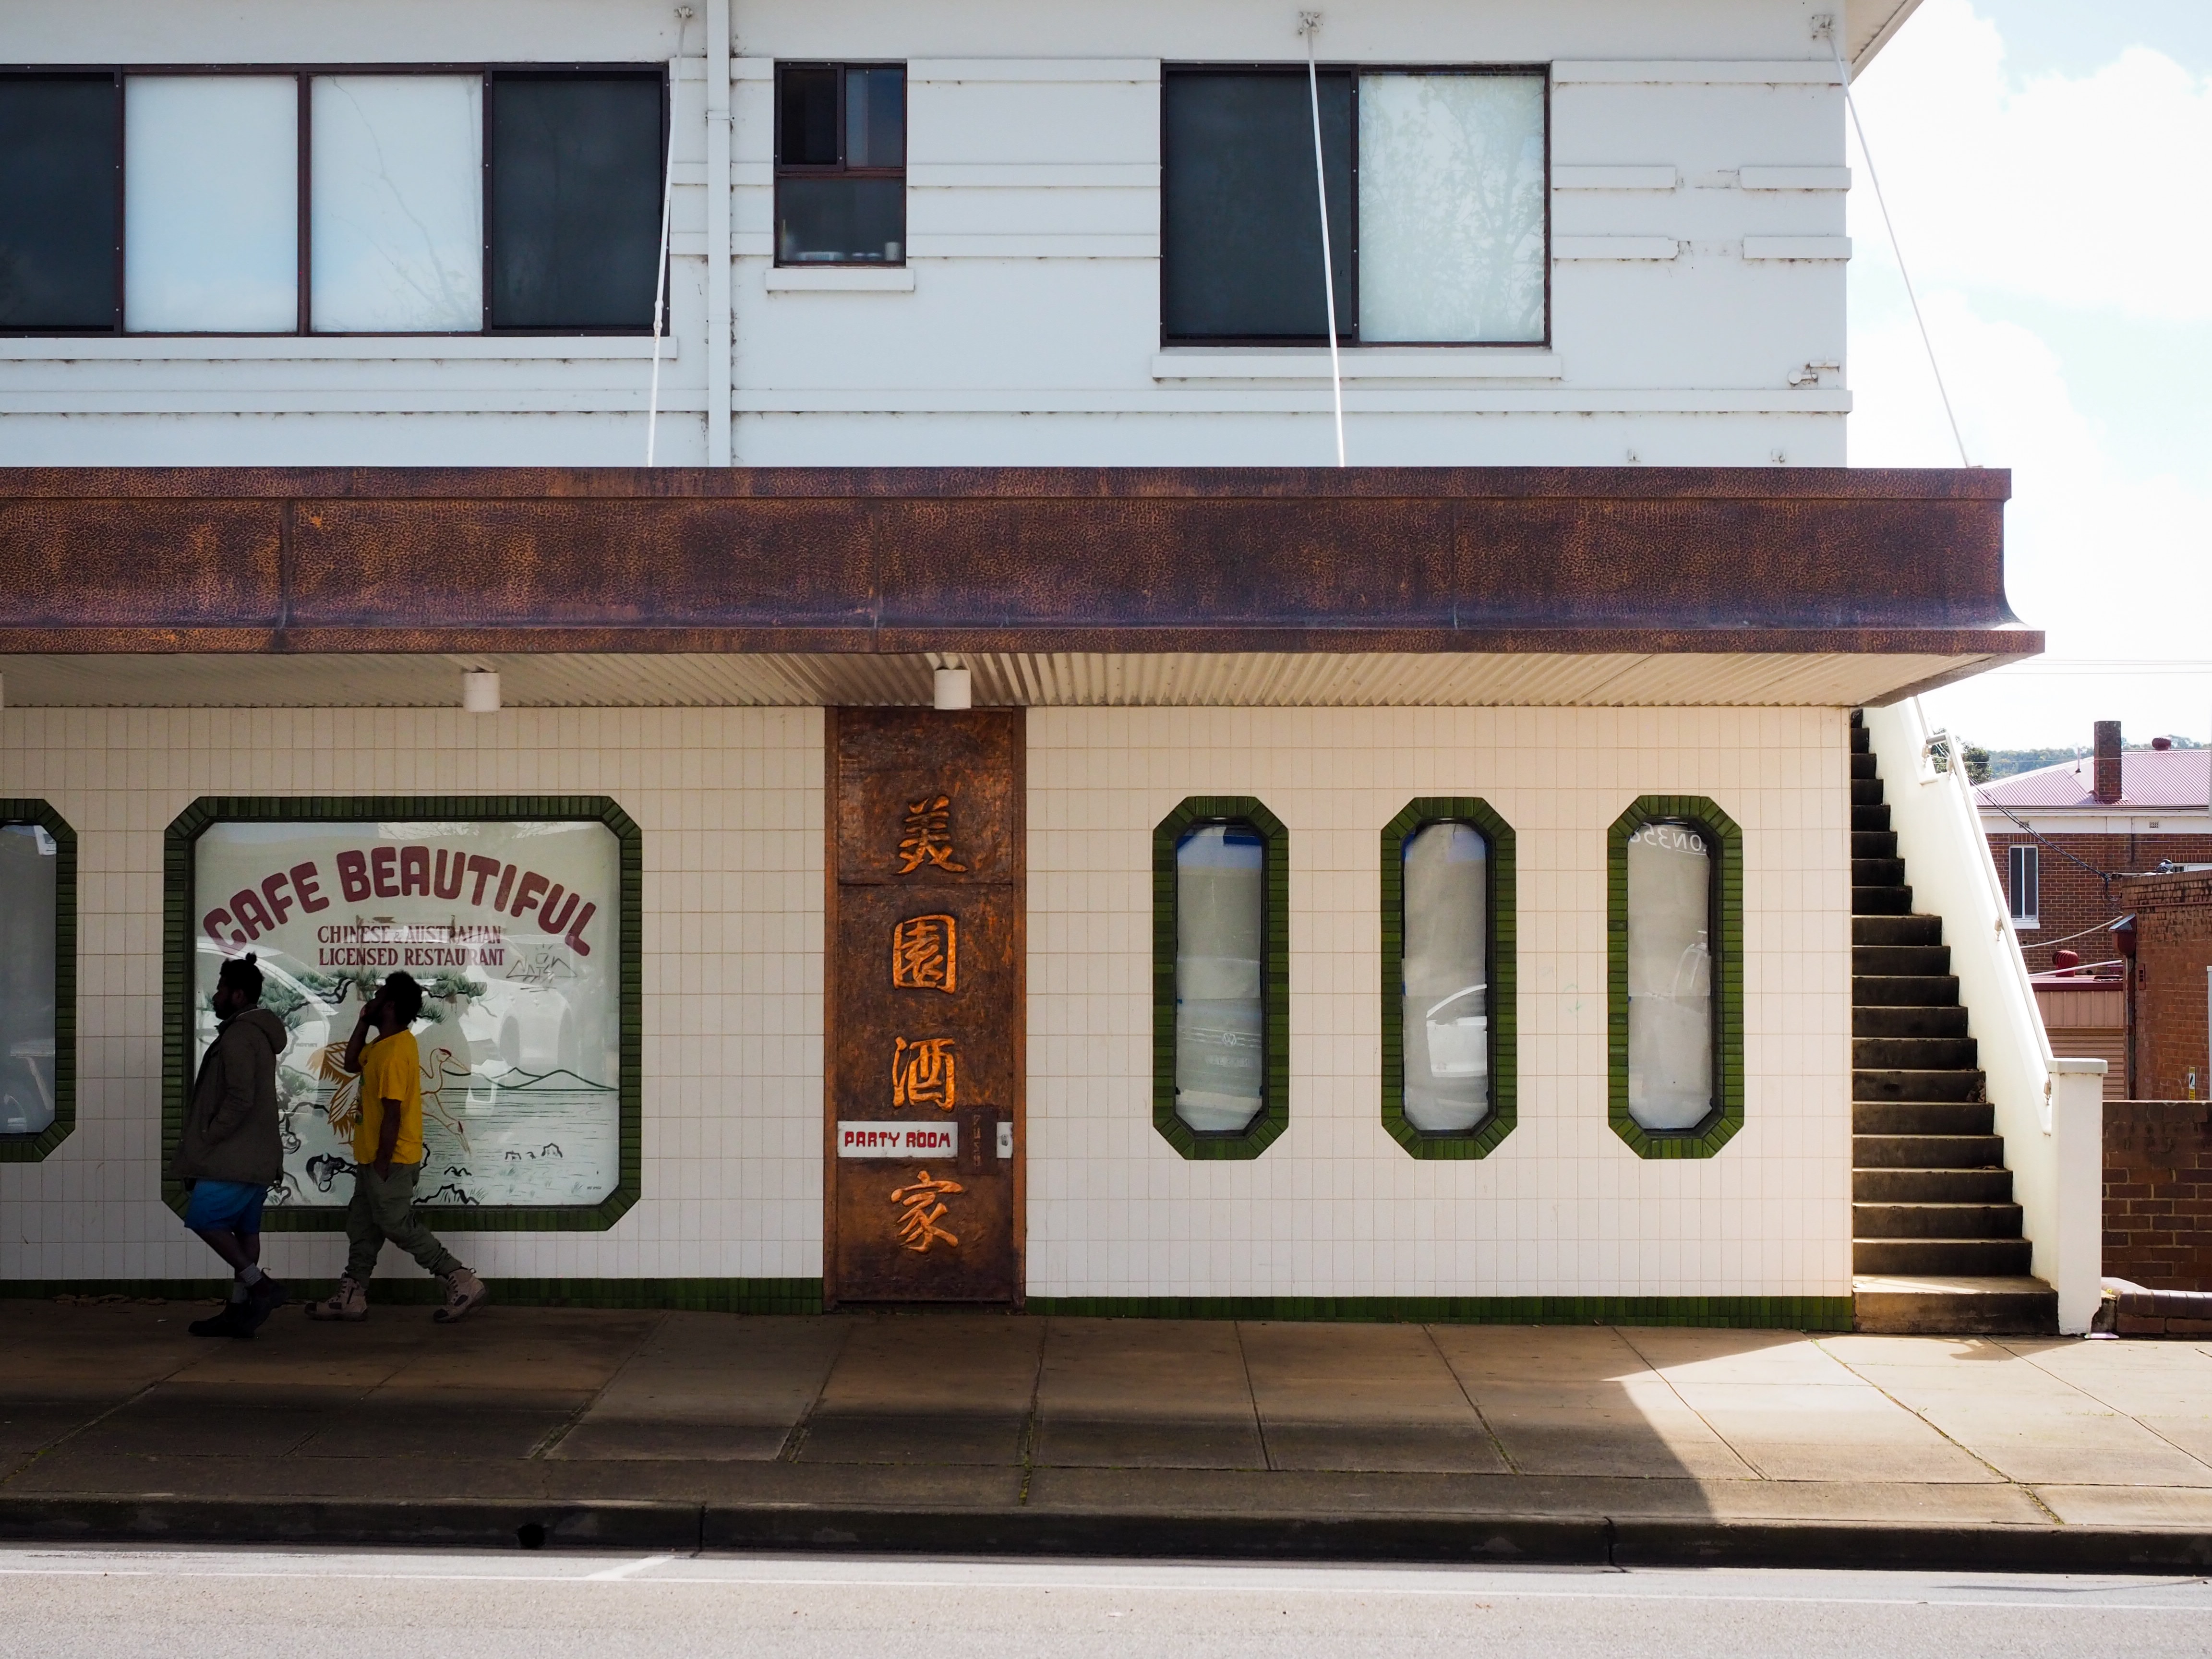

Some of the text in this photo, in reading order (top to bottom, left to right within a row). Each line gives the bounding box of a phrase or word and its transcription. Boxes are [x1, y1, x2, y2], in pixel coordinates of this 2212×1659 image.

[203, 846, 597, 956] CAFE BEAUTIFUL
[317, 925, 501, 944] CHINESE & AUSTRALIAN
[319, 948, 505, 966] LICENSED RESTAURANT
[844, 1131, 951, 1148] PARTY ROOM
